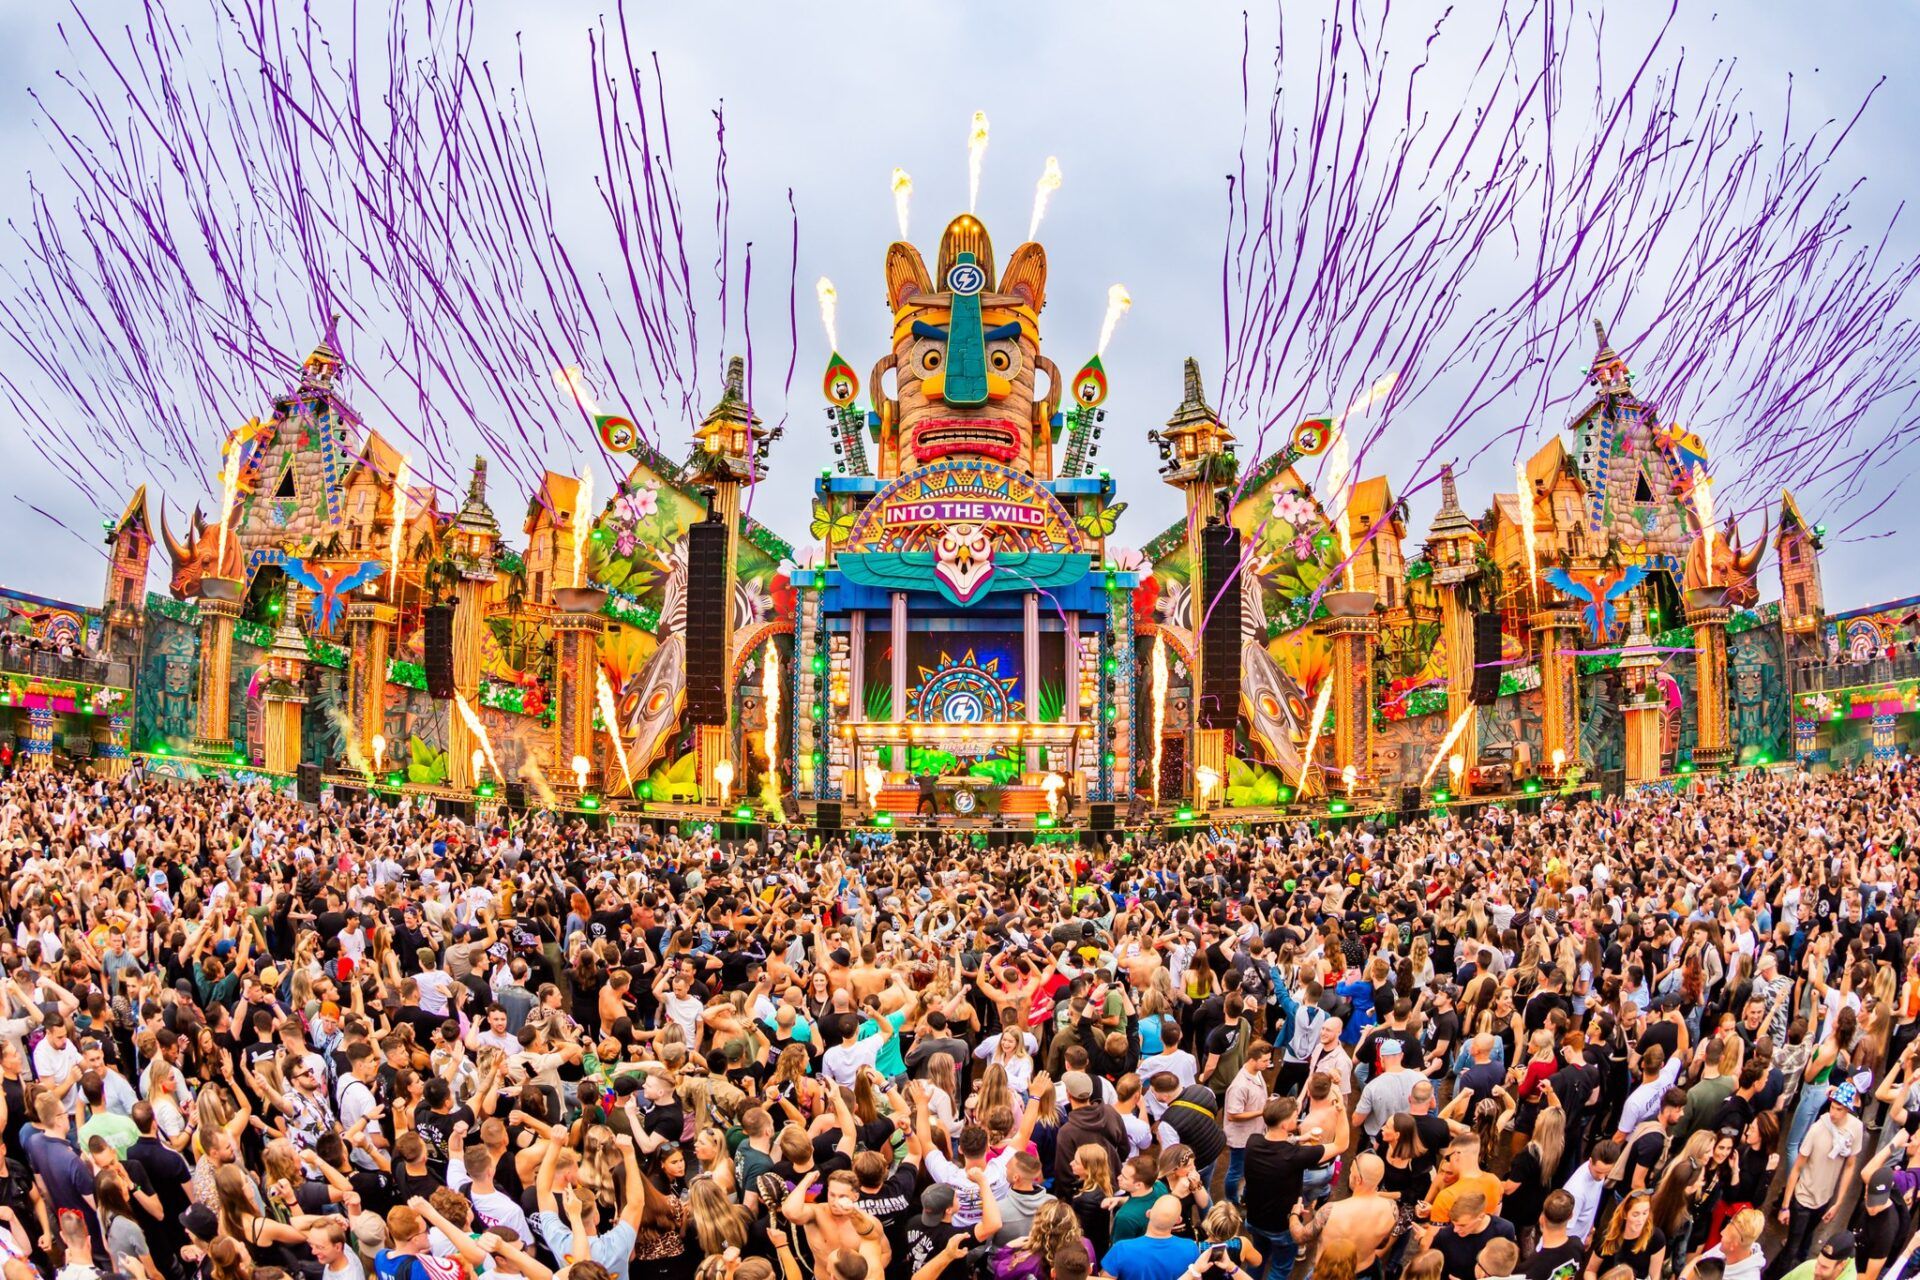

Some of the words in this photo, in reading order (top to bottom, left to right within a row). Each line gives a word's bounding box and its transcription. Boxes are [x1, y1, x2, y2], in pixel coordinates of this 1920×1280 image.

[887, 504, 936, 522] INTO
[941, 504, 985, 518] THE
[990, 505, 1044, 524] WILD
